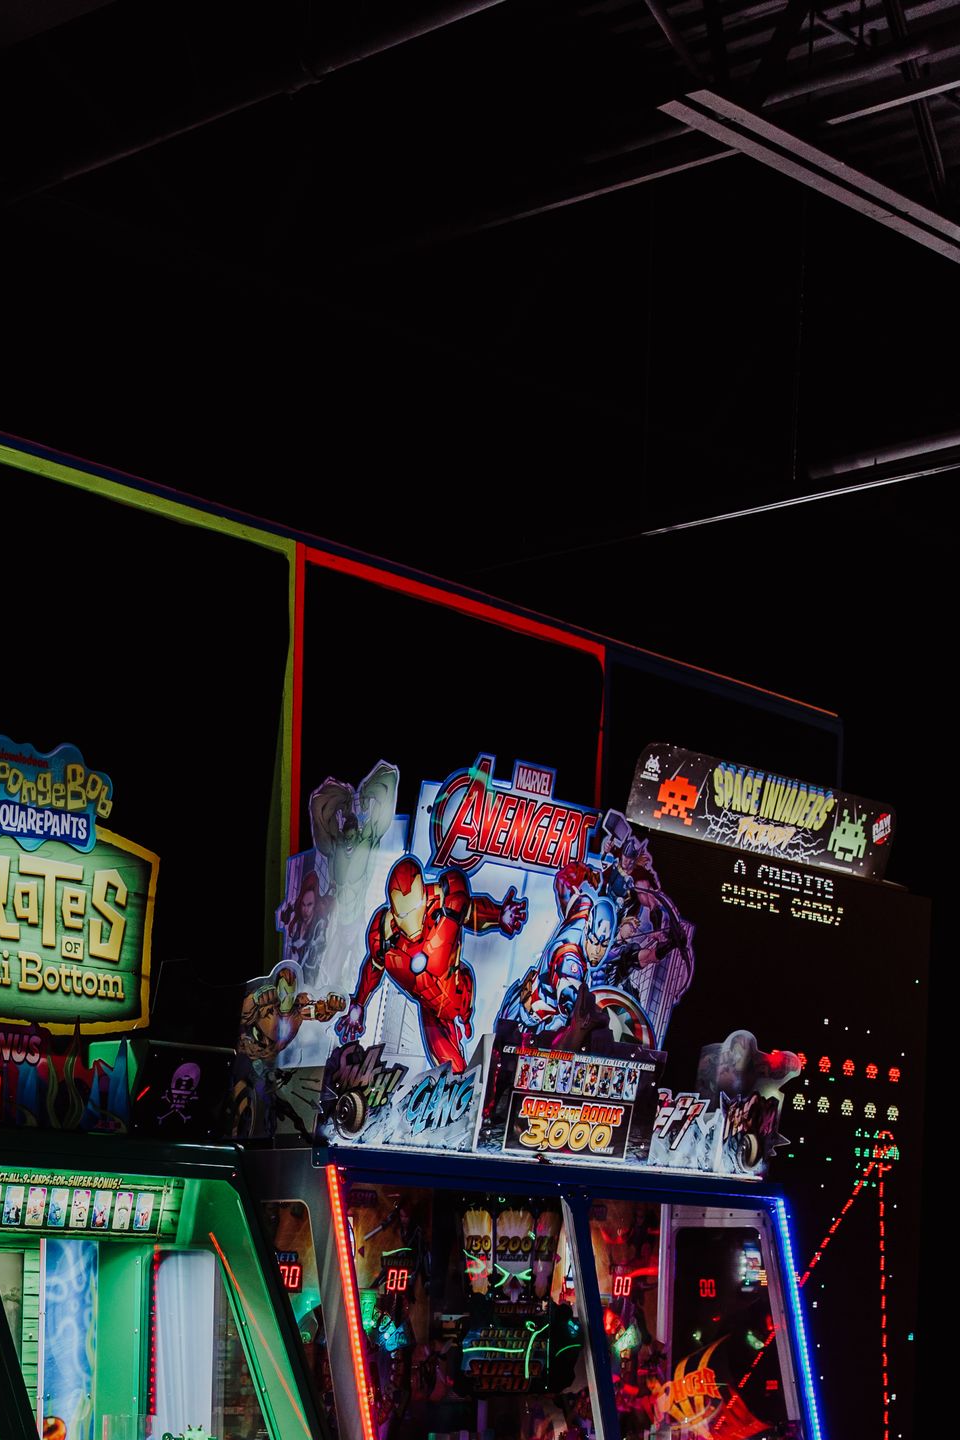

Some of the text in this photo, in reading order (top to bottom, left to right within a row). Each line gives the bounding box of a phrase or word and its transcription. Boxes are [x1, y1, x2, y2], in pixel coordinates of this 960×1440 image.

[516, 767, 552, 796] MARVEL
[713, 763, 836, 832] SPACE INVADERS
[434, 760, 598, 868] AVENGERS
[64, 940, 82, 954] OF
[18, 950, 125, 1000] Bottom
[520, 1096, 562, 1119] SUPER
[581, 1103, 625, 1127] BONUS
[519, 1117, 613, 1151] 3,000
[9, 1172, 21, 1183] ALL
[30, 1173, 50, 1186] CARDS
[51, 1175, 66, 1186] FOR
[68, 1175, 91, 1187] SUPER
[92, 1176, 123, 1190] BONUS!
[613, 1276, 632, 1297] 00
